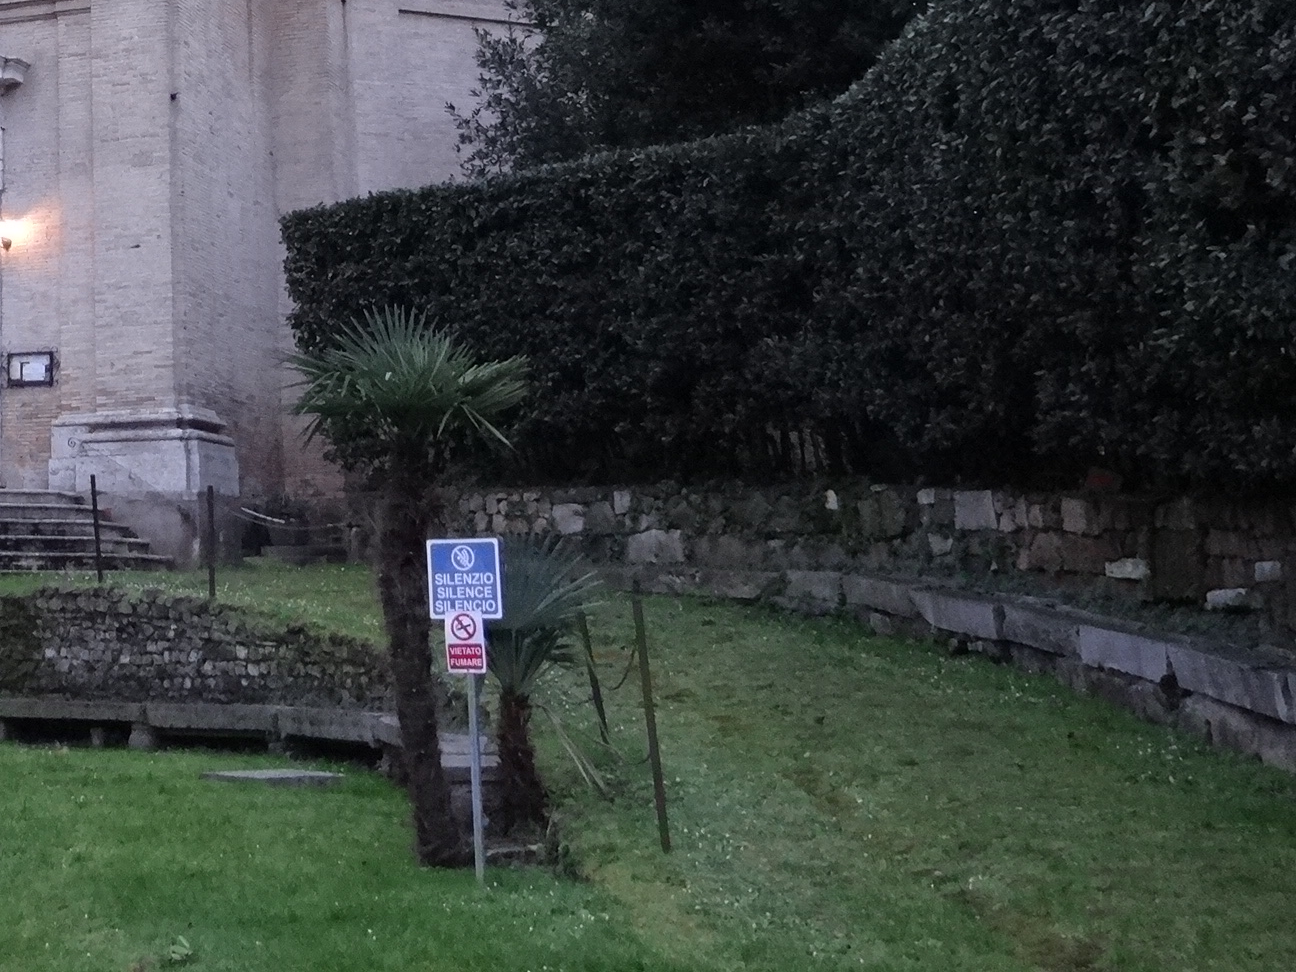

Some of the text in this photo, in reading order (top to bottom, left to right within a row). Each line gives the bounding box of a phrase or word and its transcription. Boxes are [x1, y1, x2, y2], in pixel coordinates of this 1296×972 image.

[435, 573, 493, 585] SILENZIO
[437, 586, 492, 598] SILENCE
[435, 600, 495, 612] SILENCIO
[449, 647, 481, 656] VIETATO
[450, 658, 482, 666] FUMARE
